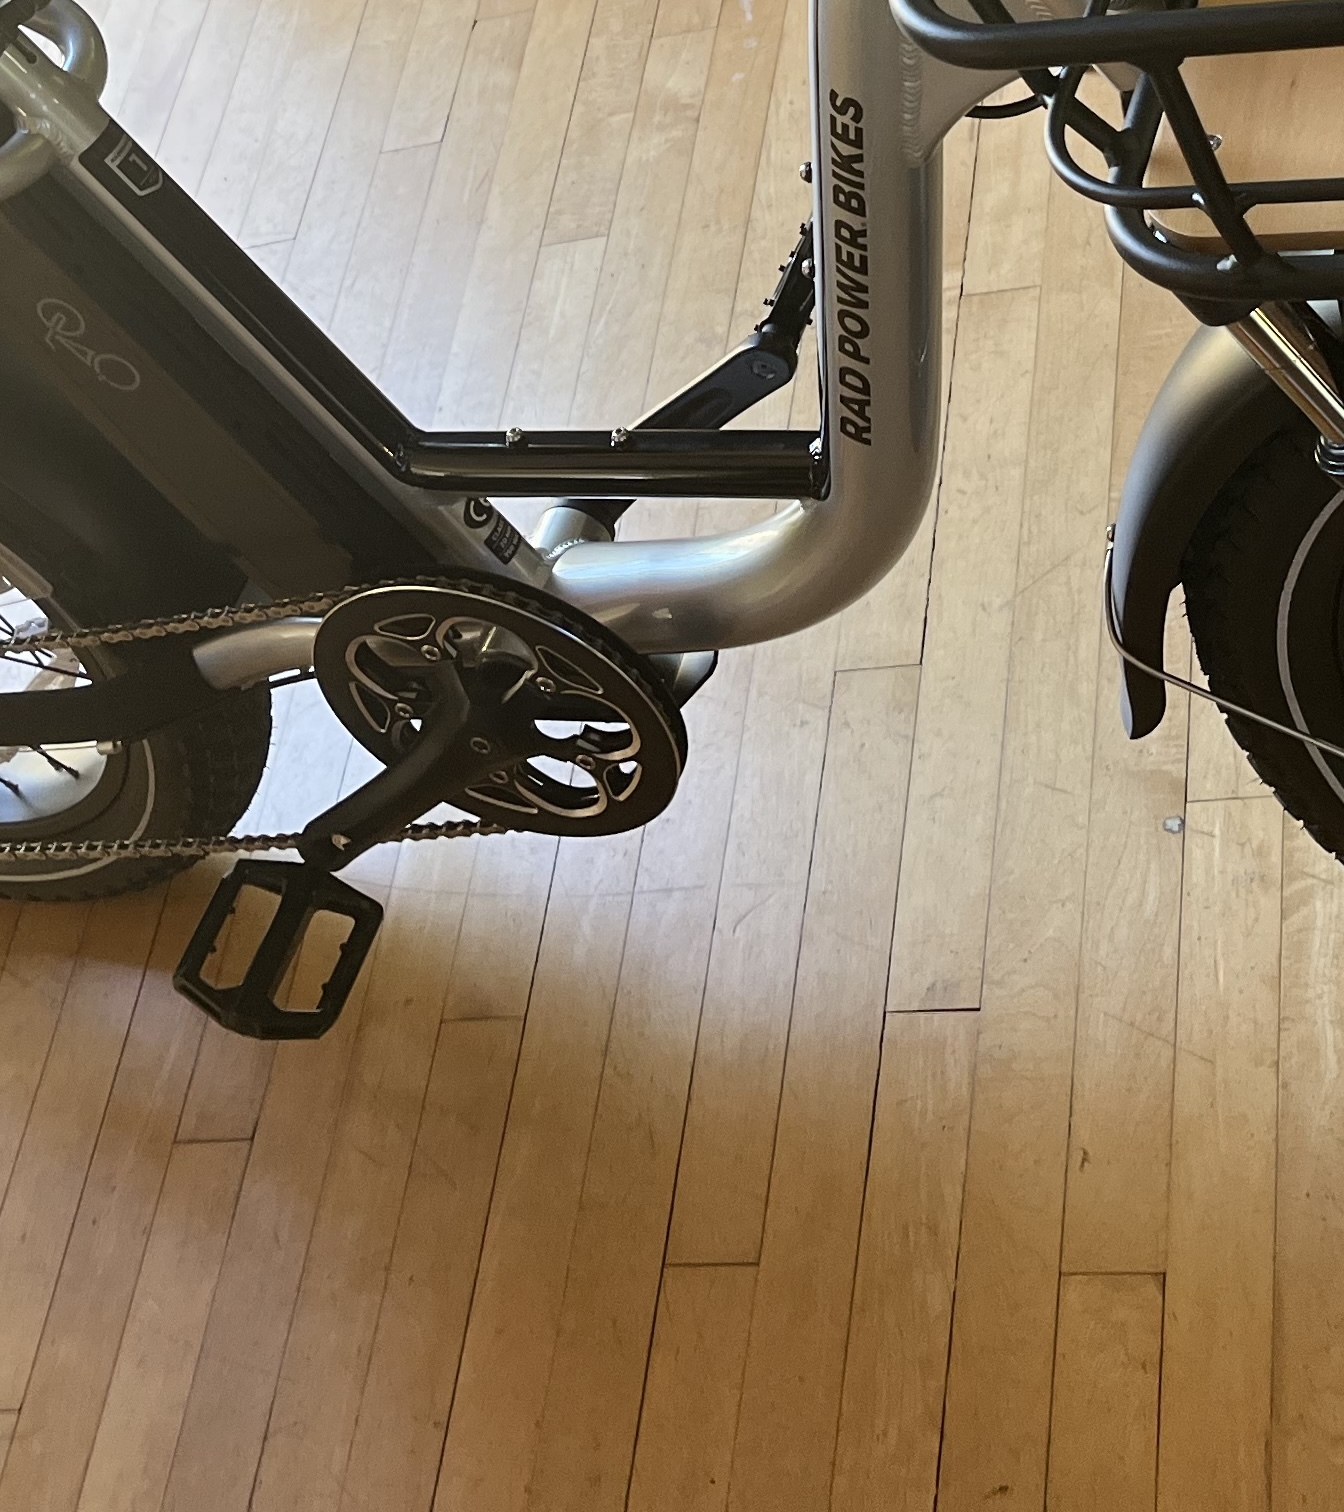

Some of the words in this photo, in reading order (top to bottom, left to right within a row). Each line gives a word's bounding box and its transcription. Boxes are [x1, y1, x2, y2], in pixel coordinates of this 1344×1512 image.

[829, 88, 867, 218] BIKES
[834, 219, 871, 365] POWER
[839, 366, 872, 446] RAD
